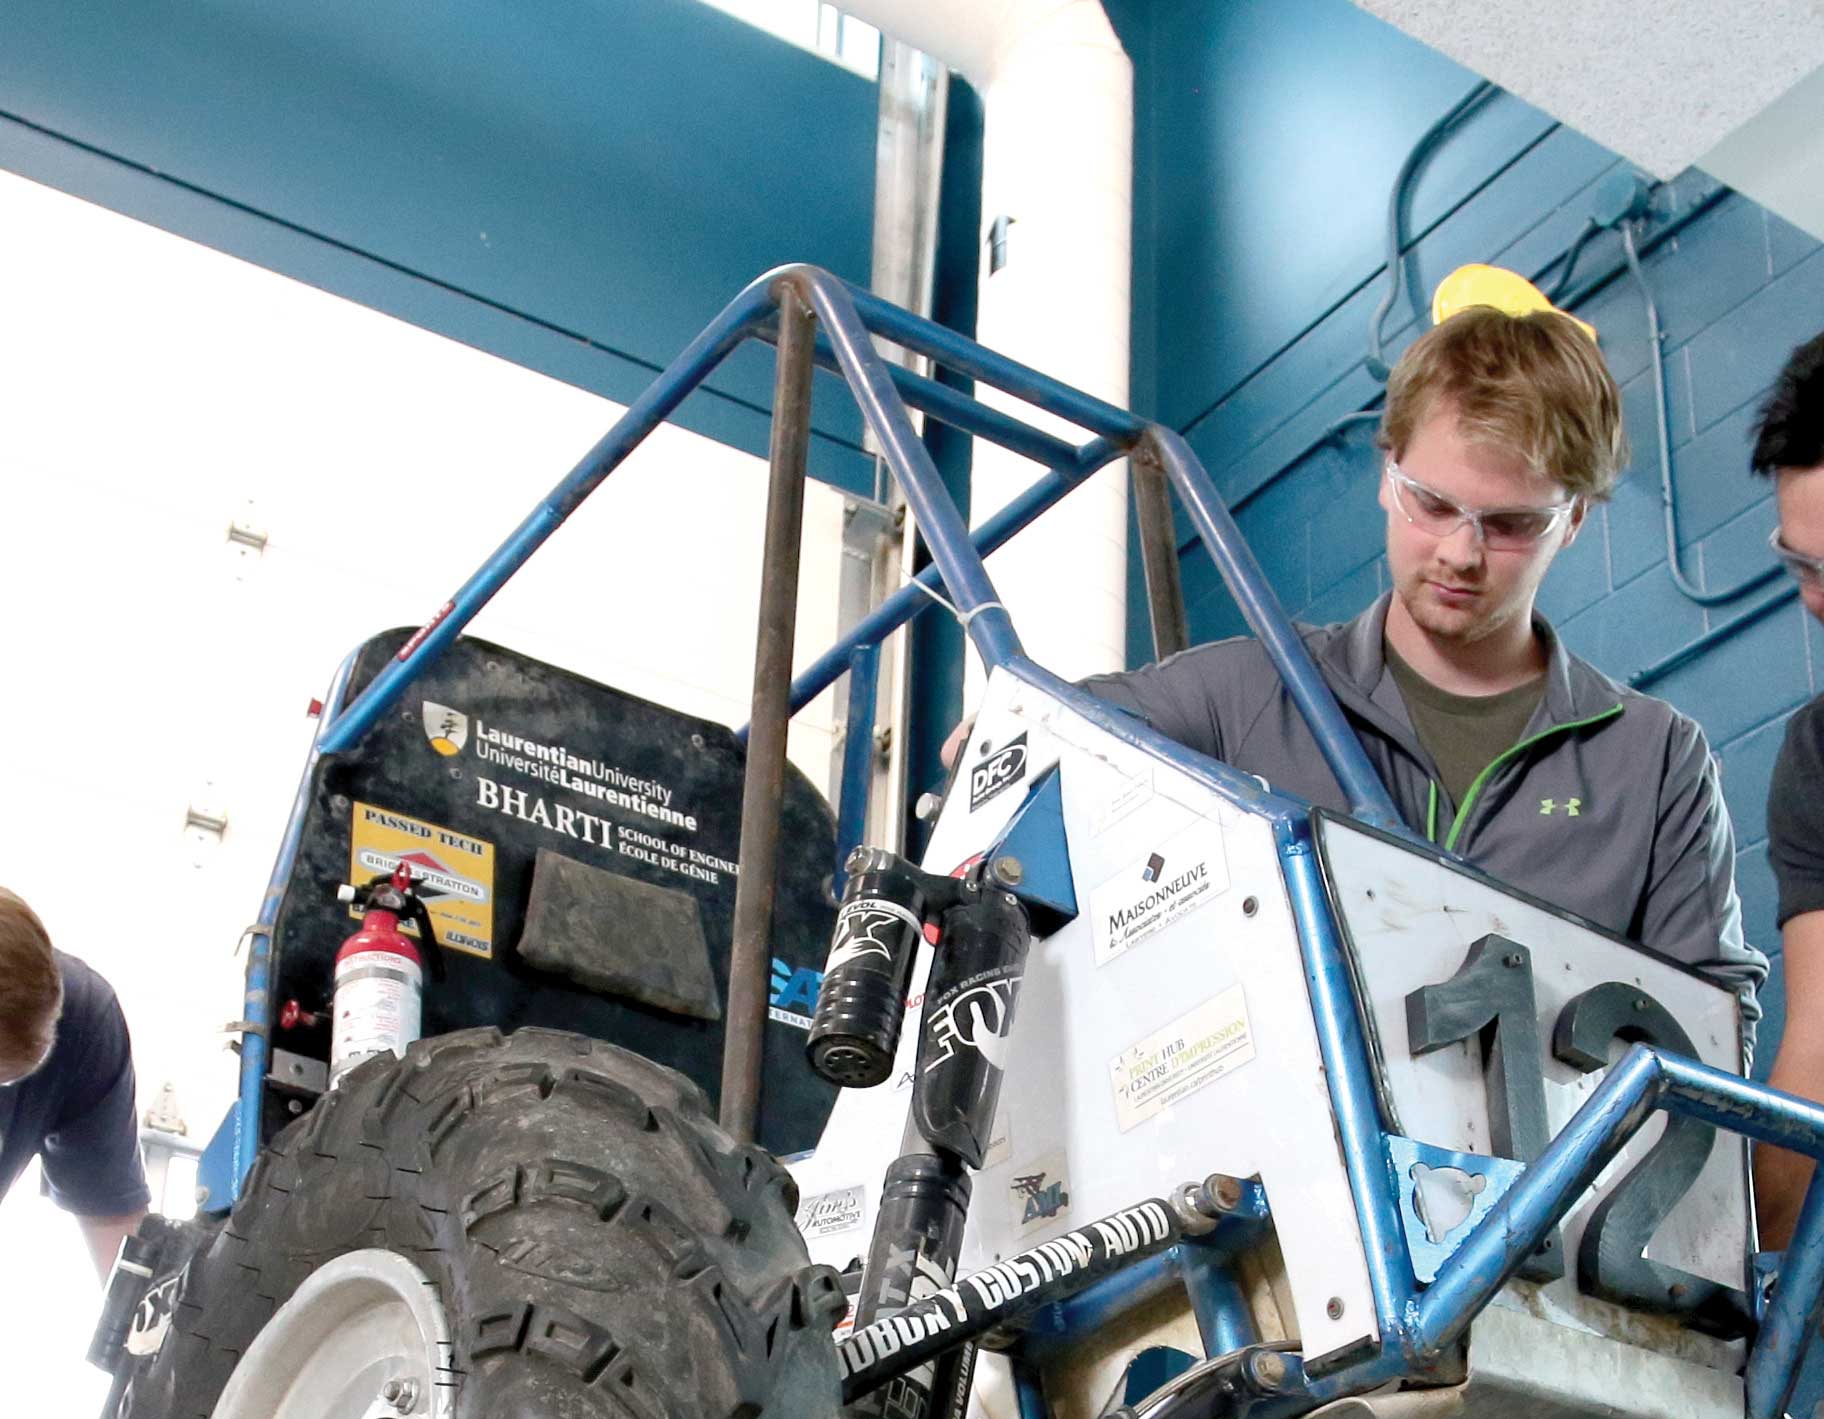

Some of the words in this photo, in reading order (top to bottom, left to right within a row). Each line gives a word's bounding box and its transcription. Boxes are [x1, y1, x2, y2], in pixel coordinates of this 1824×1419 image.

[973, 751, 1013, 797] DFC
[364, 809, 432, 838] PASSED
[438, 831, 483, 855] TECH
[477, 777, 613, 849] BHARTI
[618, 842, 659, 865] ÉCOLE
[661, 855, 678, 871] DE
[680, 860, 719, 885] GÉNIE
[619, 825, 667, 852] SCHOOL
[670, 842, 688, 858] OF
[366, 854, 398, 870] BRIG
[423, 871, 479, 897] STRATTON
[1092, 1202, 1170, 1260] AUTO
